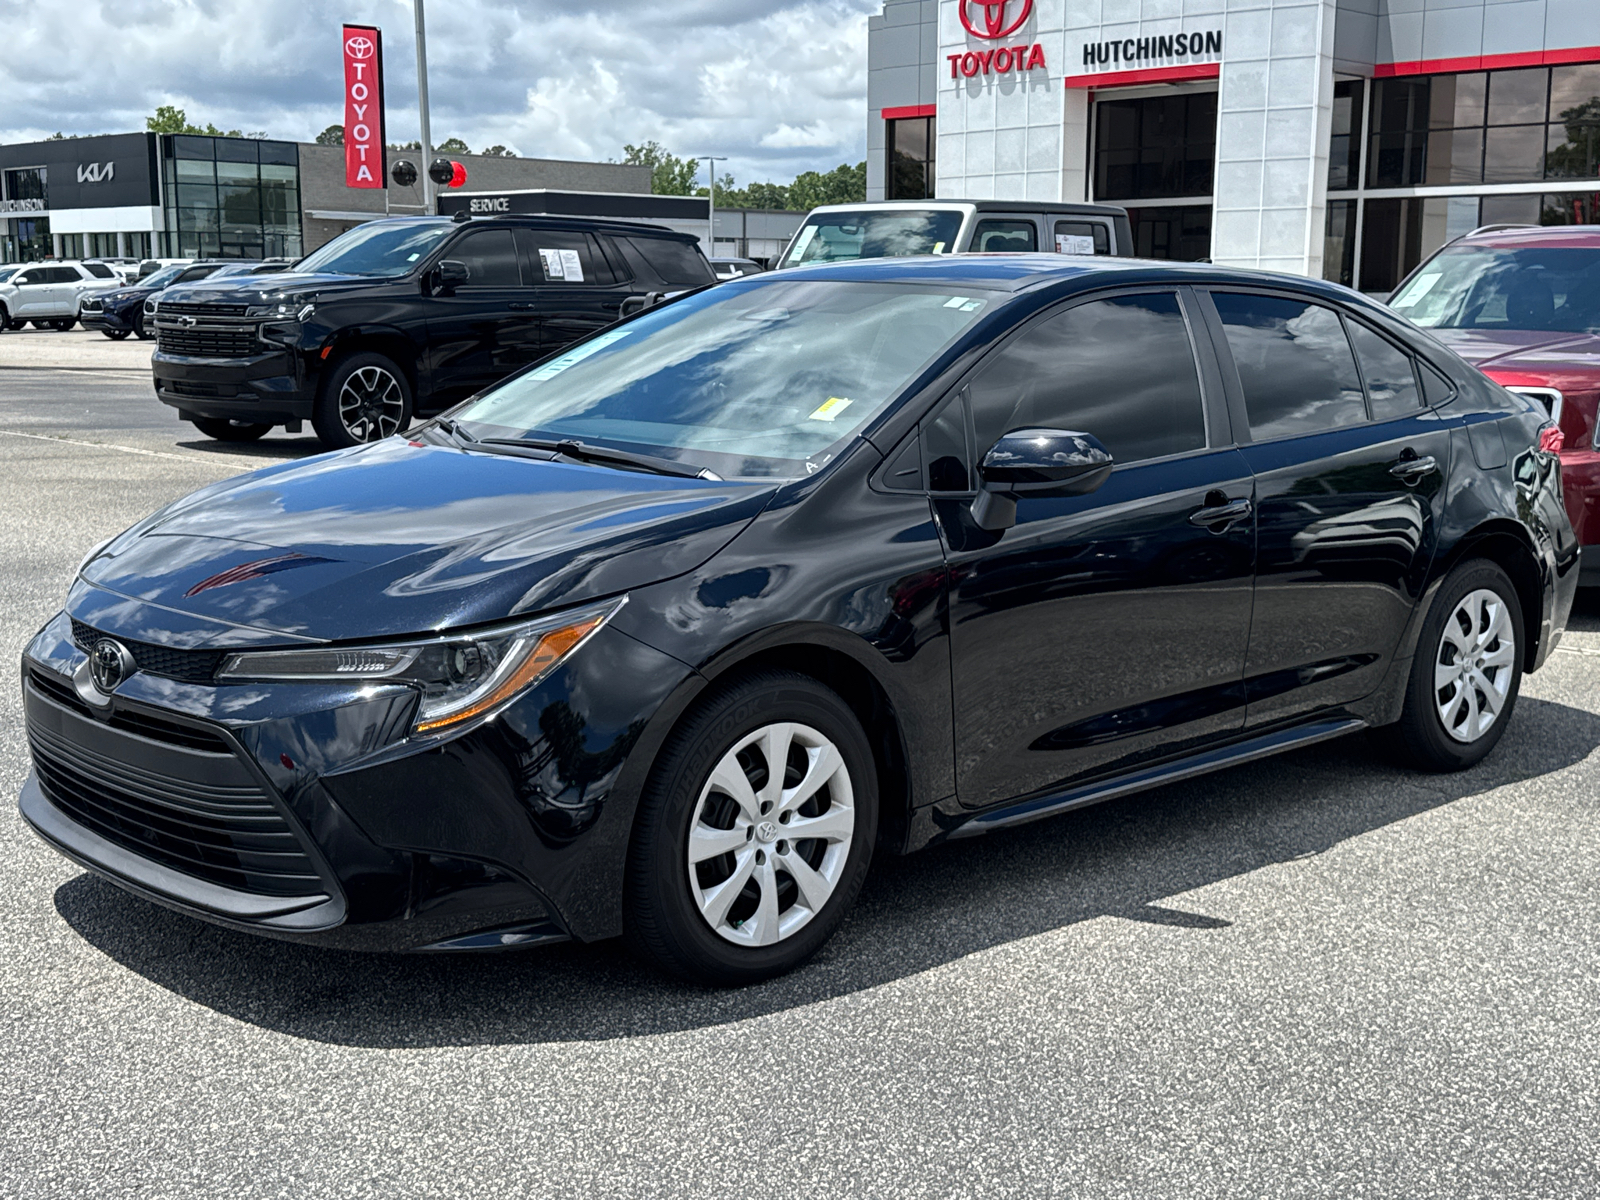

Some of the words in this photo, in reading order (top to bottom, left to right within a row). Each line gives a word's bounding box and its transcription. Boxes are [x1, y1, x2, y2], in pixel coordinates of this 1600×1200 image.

[947, 43, 1046, 79] TOYOTA
[1083, 30, 1222, 66] HUTCHINSON
[351, 63, 373, 181] TOYOTA
[77, 161, 114, 183] KIA
[0, 198, 44, 212] UTCHINSON
[470, 197, 510, 212] SERVICE
